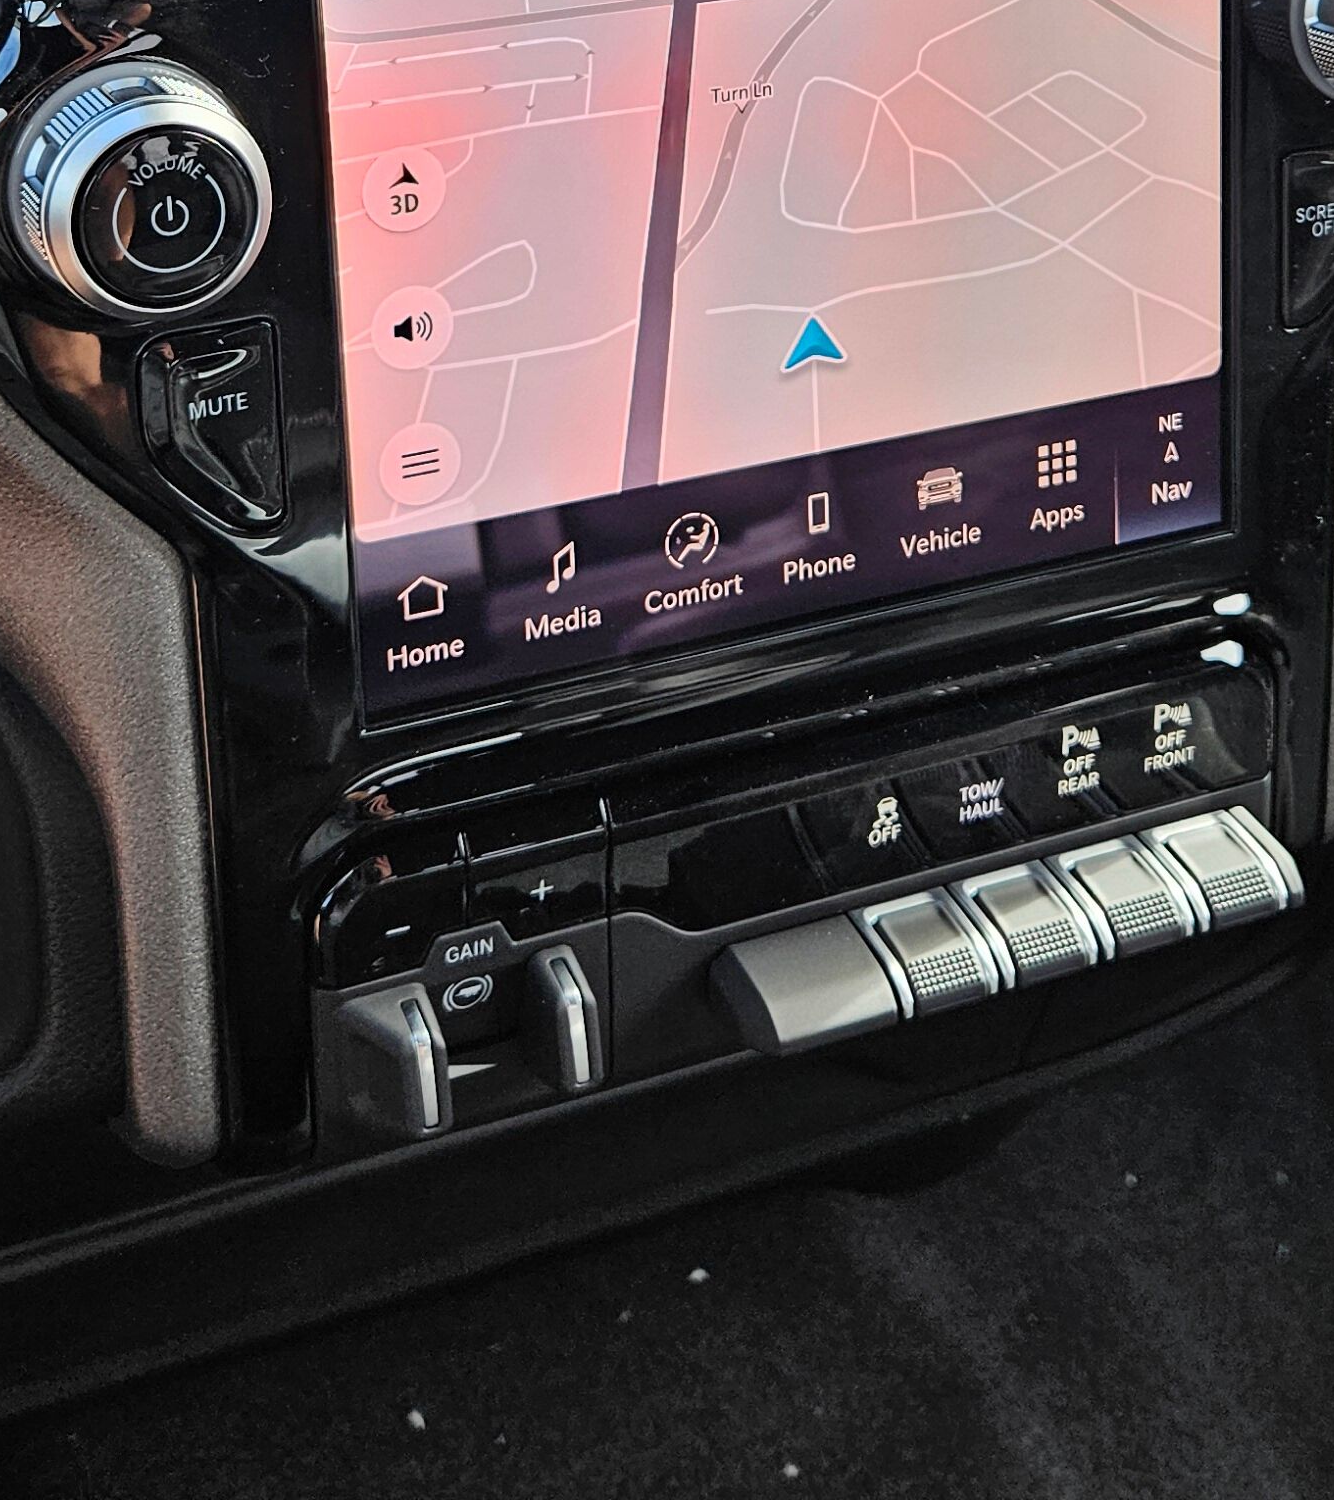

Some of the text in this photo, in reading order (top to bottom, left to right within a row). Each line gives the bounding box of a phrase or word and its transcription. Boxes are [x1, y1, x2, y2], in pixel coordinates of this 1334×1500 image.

[710, 82, 773, 104] Turn Ln
[127, 155, 207, 188] VOLUME
[389, 192, 420, 216] 3D
[188, 390, 250, 422] MUTE
[1157, 412, 1185, 434] NE
[1150, 479, 1194, 506] Nav
[1028, 501, 1086, 533] Apps
[899, 522, 983, 559] Vehicle
[782, 549, 857, 585] Phone
[643, 573, 745, 616] Comfort
[523, 604, 603, 642] Media
[385, 635, 466, 673] Home
[1154, 728, 1187, 752] OFF
[1063, 752, 1096, 777] OFF
[1144, 745, 1195, 774] FRONT
[959, 778, 1005, 803] TOW/
[1057, 770, 1100, 798] REAR
[958, 796, 1004, 824] HAUL
[868, 823, 902, 848] OFF
[445, 937, 494, 963] GAIN
